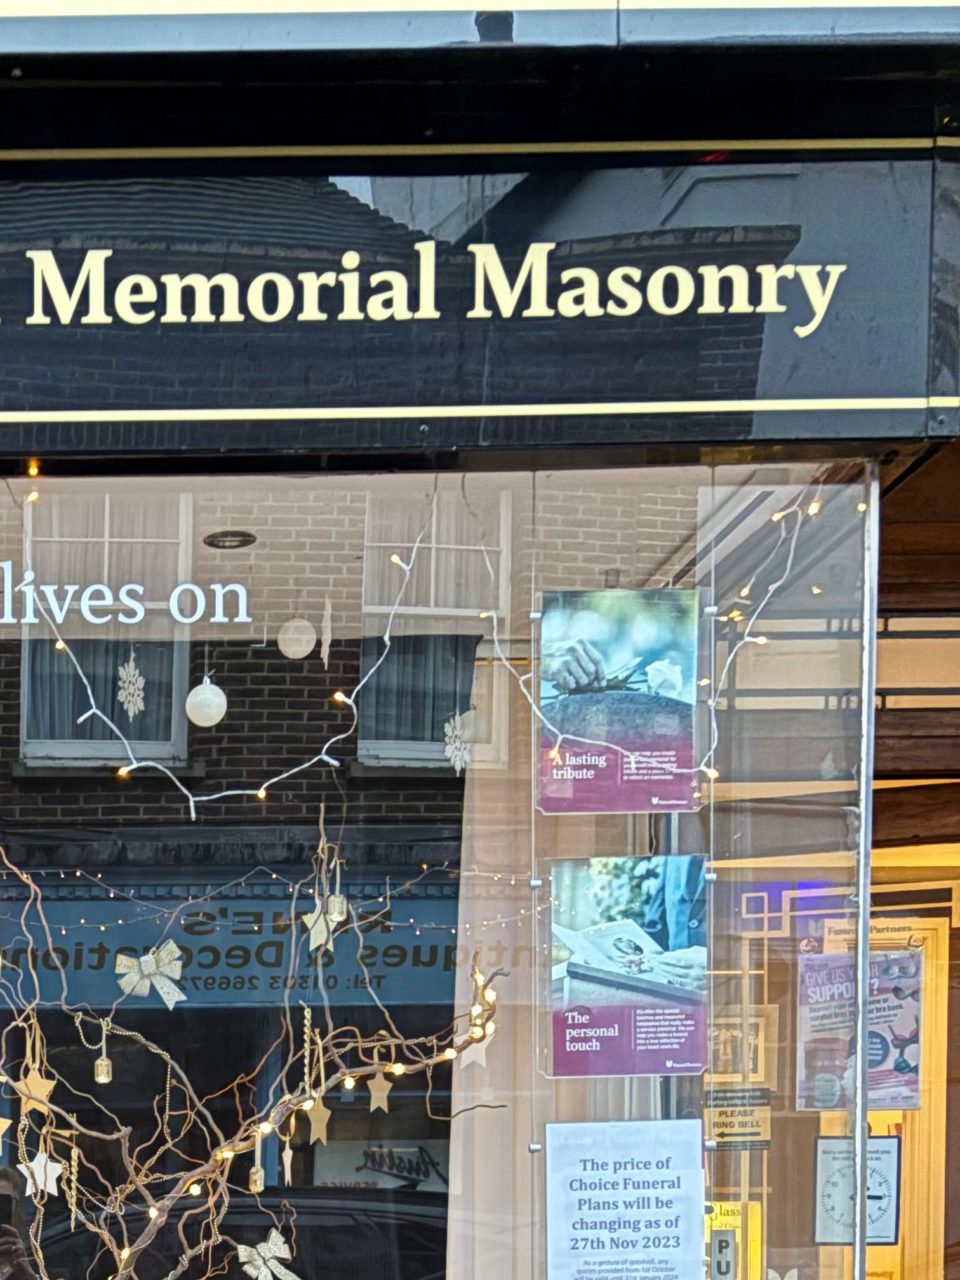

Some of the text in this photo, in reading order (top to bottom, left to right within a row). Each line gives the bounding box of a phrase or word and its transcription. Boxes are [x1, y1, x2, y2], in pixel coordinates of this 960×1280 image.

[25, 240, 440, 325] Memorial
[467, 241, 847, 337] Masonry
[169, 580, 252, 625] on
[565, 753, 607, 767] lasting
[552, 768, 595, 779] tribute
[805, 969, 831, 986] GIVE
[832, 967, 844, 983] US
[848, 964, 879, 981] YR
[808, 978, 879, 1003] SUPPO?
[565, 1012, 590, 1024] The
[565, 1024, 619, 1040] personal
[566, 1039, 600, 1051] touch
[718, 1109, 755, 1118] PLEASE
[713, 1120, 762, 1129] RING BELL
[579, 1156, 672, 1174] The price of
[569, 1176, 681, 1191] Choice Funeral
[577, 1196, 673, 1211] Plans will be
[572, 1216, 680, 1233] changing as of
[570, 1236, 681, 1250] 27th Nov 2023
